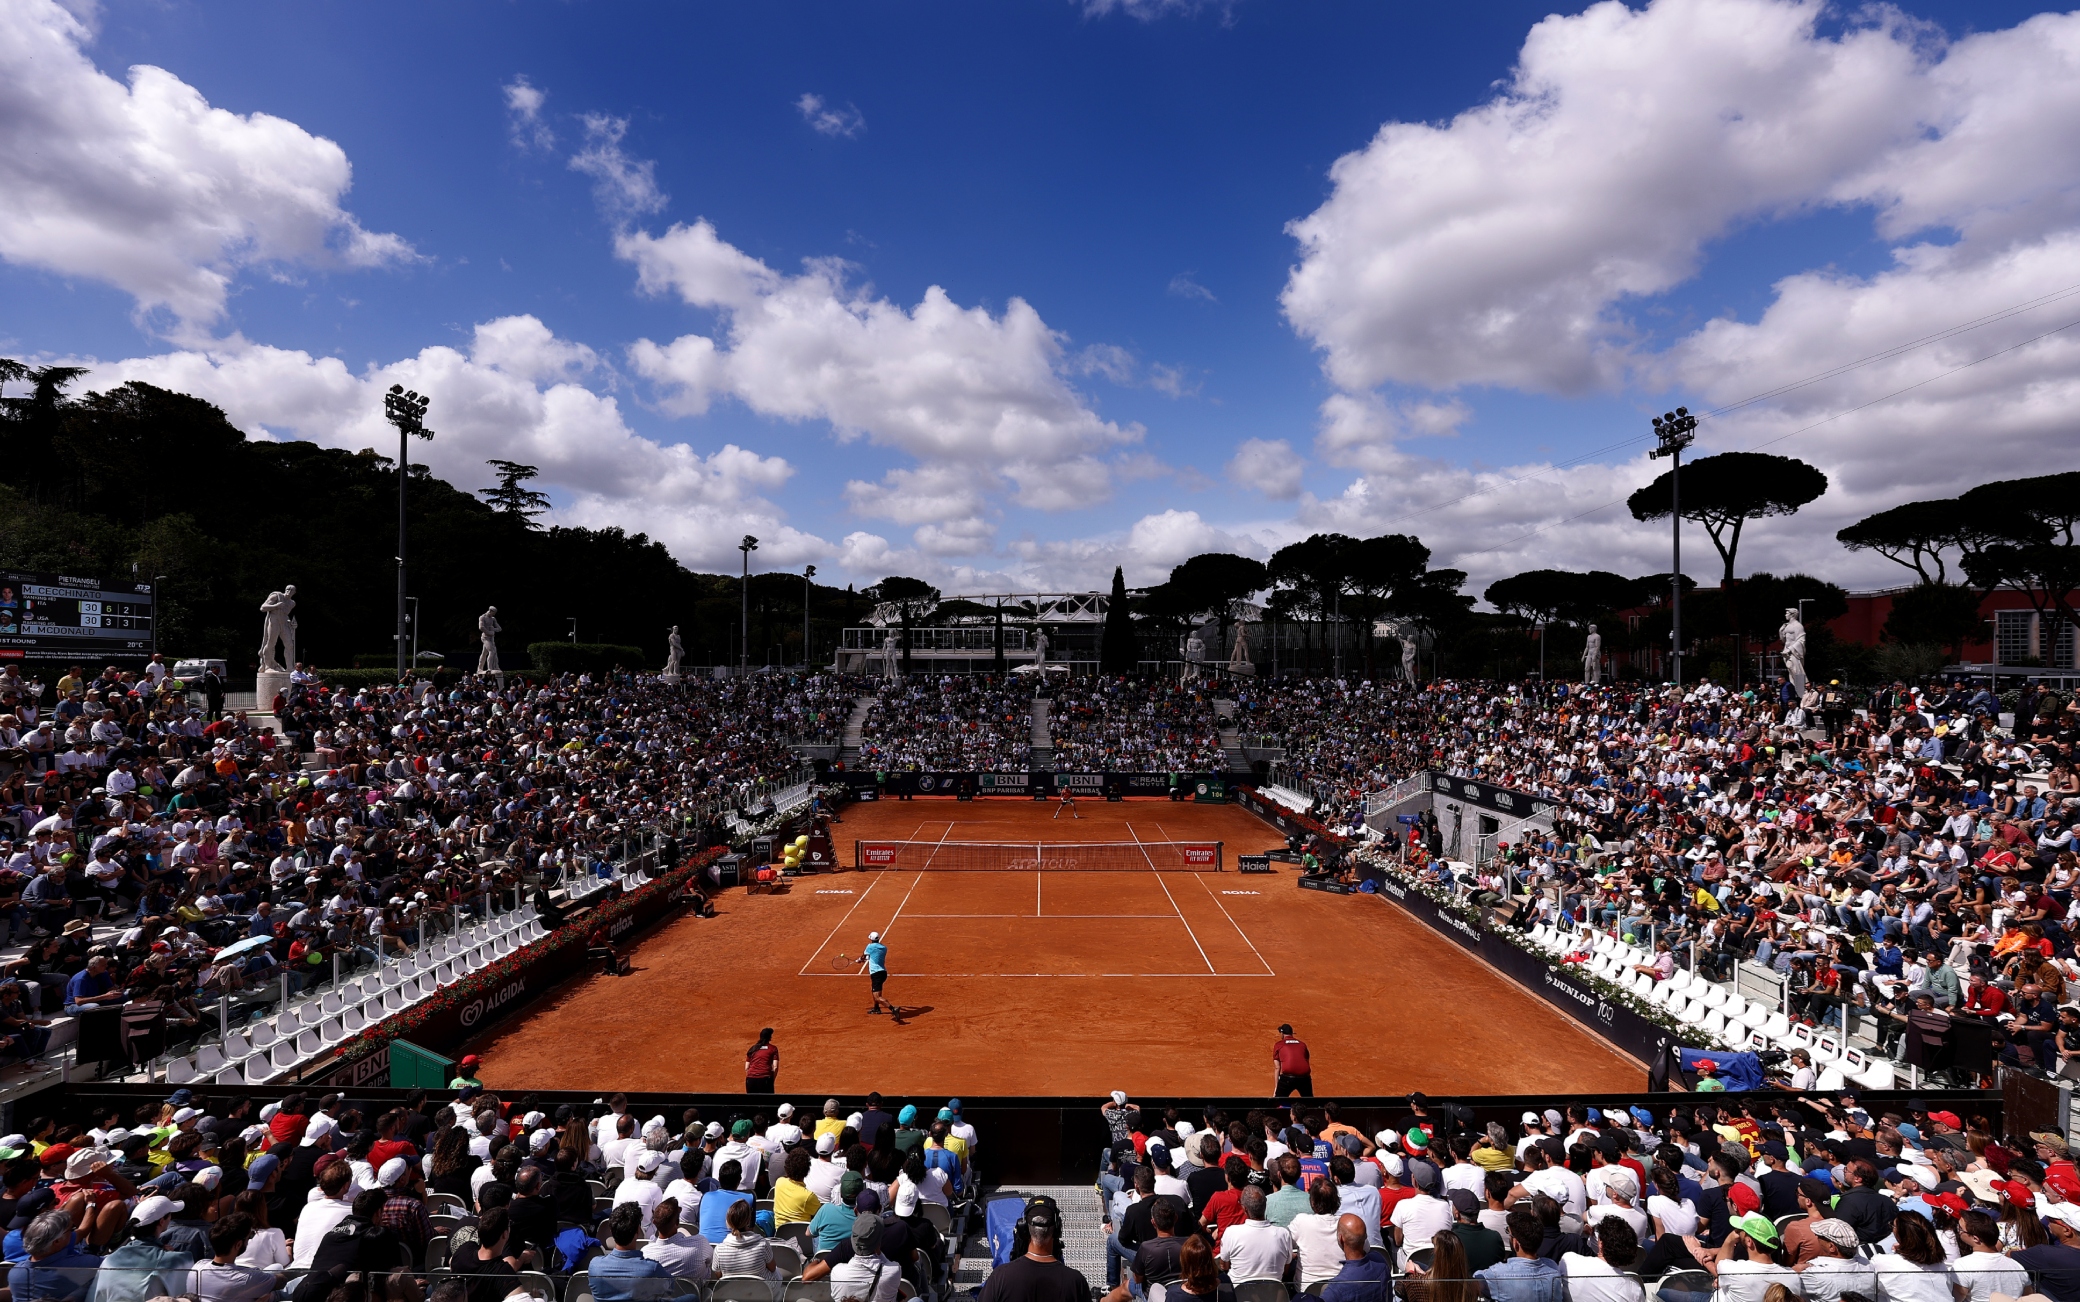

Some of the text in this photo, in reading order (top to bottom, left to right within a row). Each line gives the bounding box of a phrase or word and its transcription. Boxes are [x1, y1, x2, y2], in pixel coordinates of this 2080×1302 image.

[58, 576, 101, 586] PIETRANGELI
[23, 586, 102, 599] M. CECCHINATO
[85, 604, 129, 614] 30 6 2
[84, 616, 129, 627] 30 3 3
[37, 626, 96, 636] MCDONALD
[997, 776, 1024, 784] BNL
[1072, 776, 1100, 784] BNL
[1186, 848, 1214, 856] Emirates
[1041, 858, 1078, 870] TOUR
[1242, 861, 1269, 871] Haier
[1384, 878, 1405, 900] ticketone
[610, 914, 634, 938] nilox
[1438, 908, 1481, 942] Nitto ATP FINALS
[486, 978, 525, 1013] ALGIDA
[1552, 977, 1596, 1007] DUNLOP
[1598, 1001, 1614, 1021] 100
[357, 1048, 390, 1084] BNL
